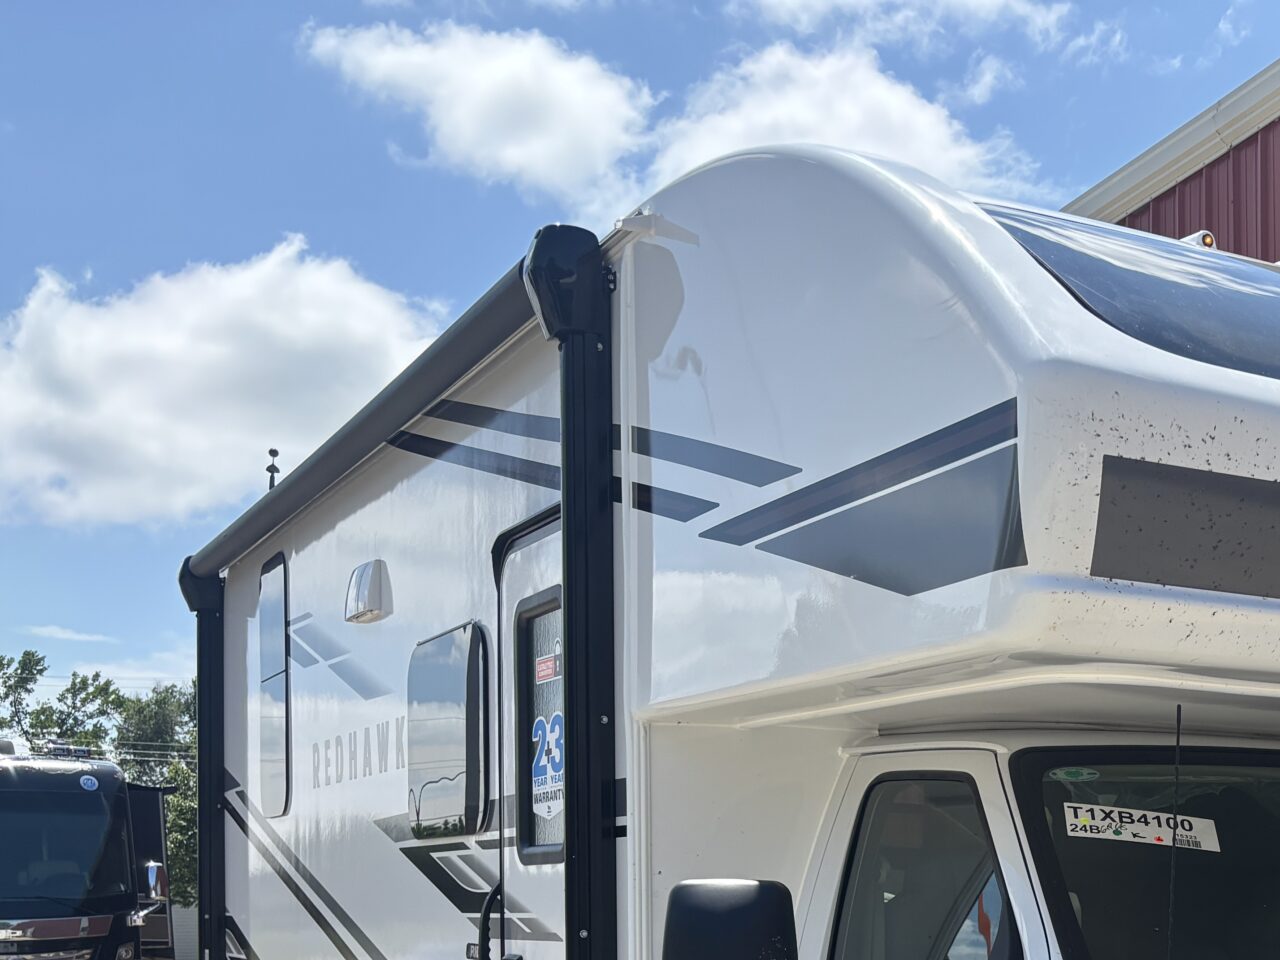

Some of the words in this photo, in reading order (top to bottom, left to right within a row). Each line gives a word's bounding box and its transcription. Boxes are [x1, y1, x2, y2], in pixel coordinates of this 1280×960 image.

[312, 715, 406, 789] REDHAWK
[533, 776, 548, 788] YEAR
[1066, 805, 1194, 832] T1XB4100
[1069, 823, 1101, 834] 24B
